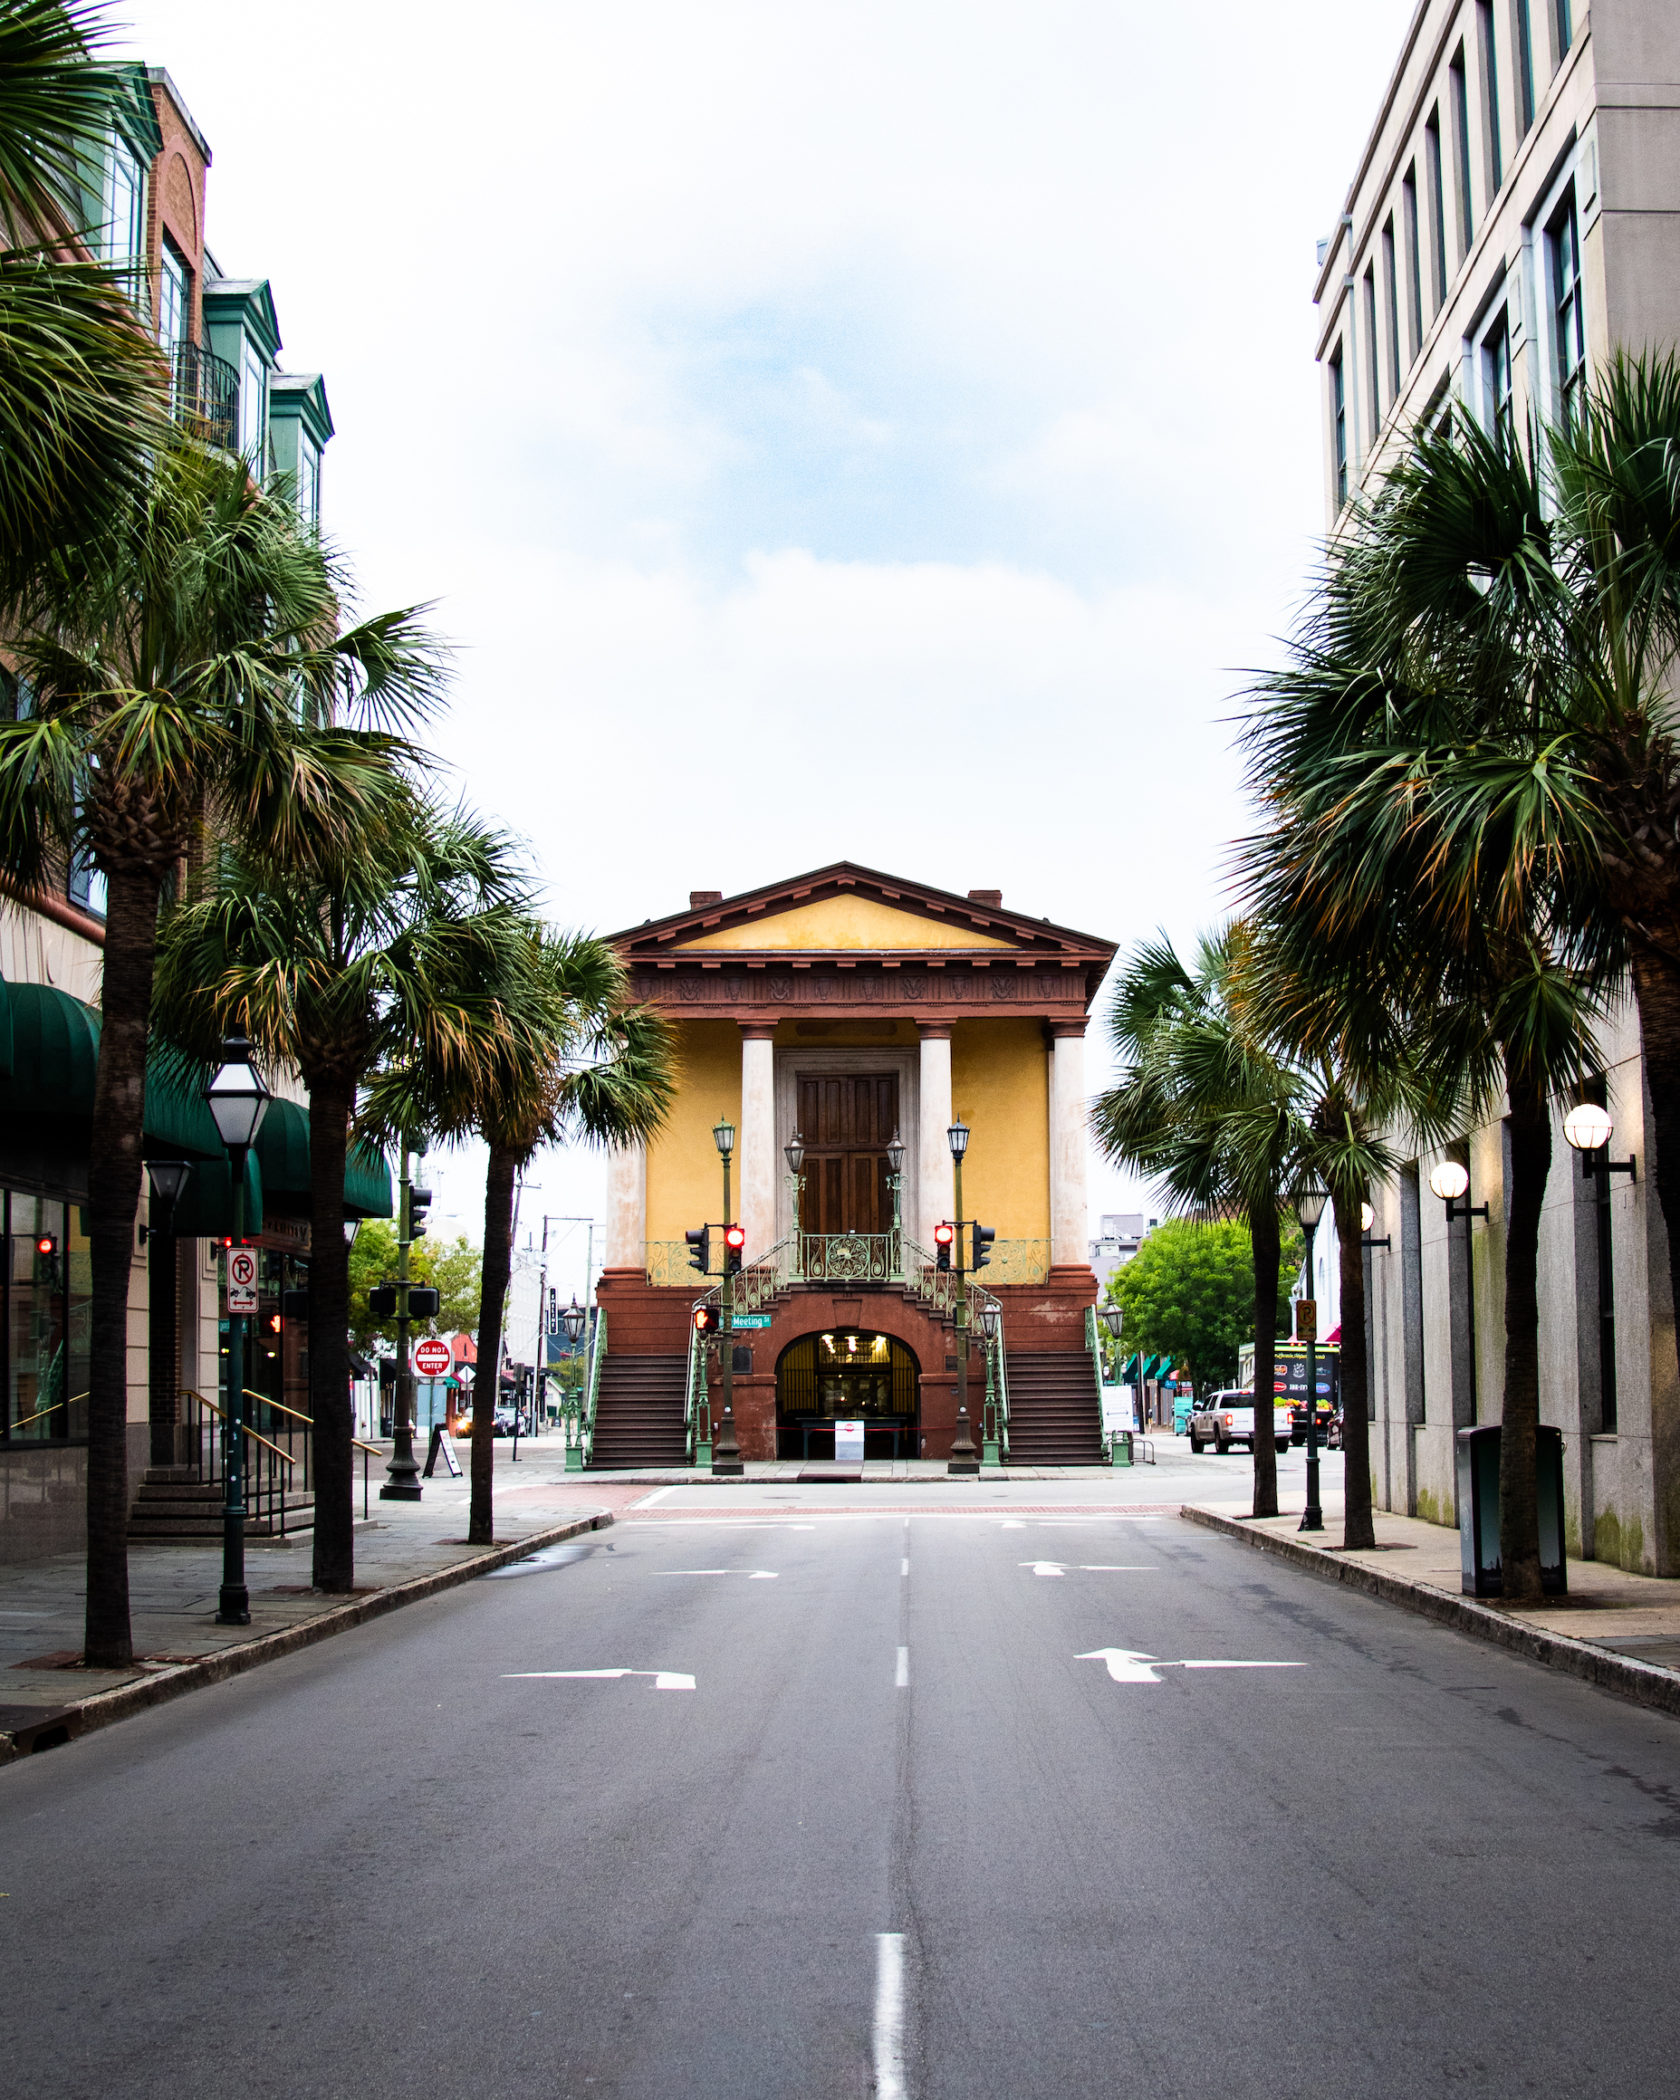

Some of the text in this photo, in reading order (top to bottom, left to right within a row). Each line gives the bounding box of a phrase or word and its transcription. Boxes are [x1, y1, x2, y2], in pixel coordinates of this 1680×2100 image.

[733, 1316, 763, 1328] Meeting
[420, 1346, 446, 1354] DO NOT
